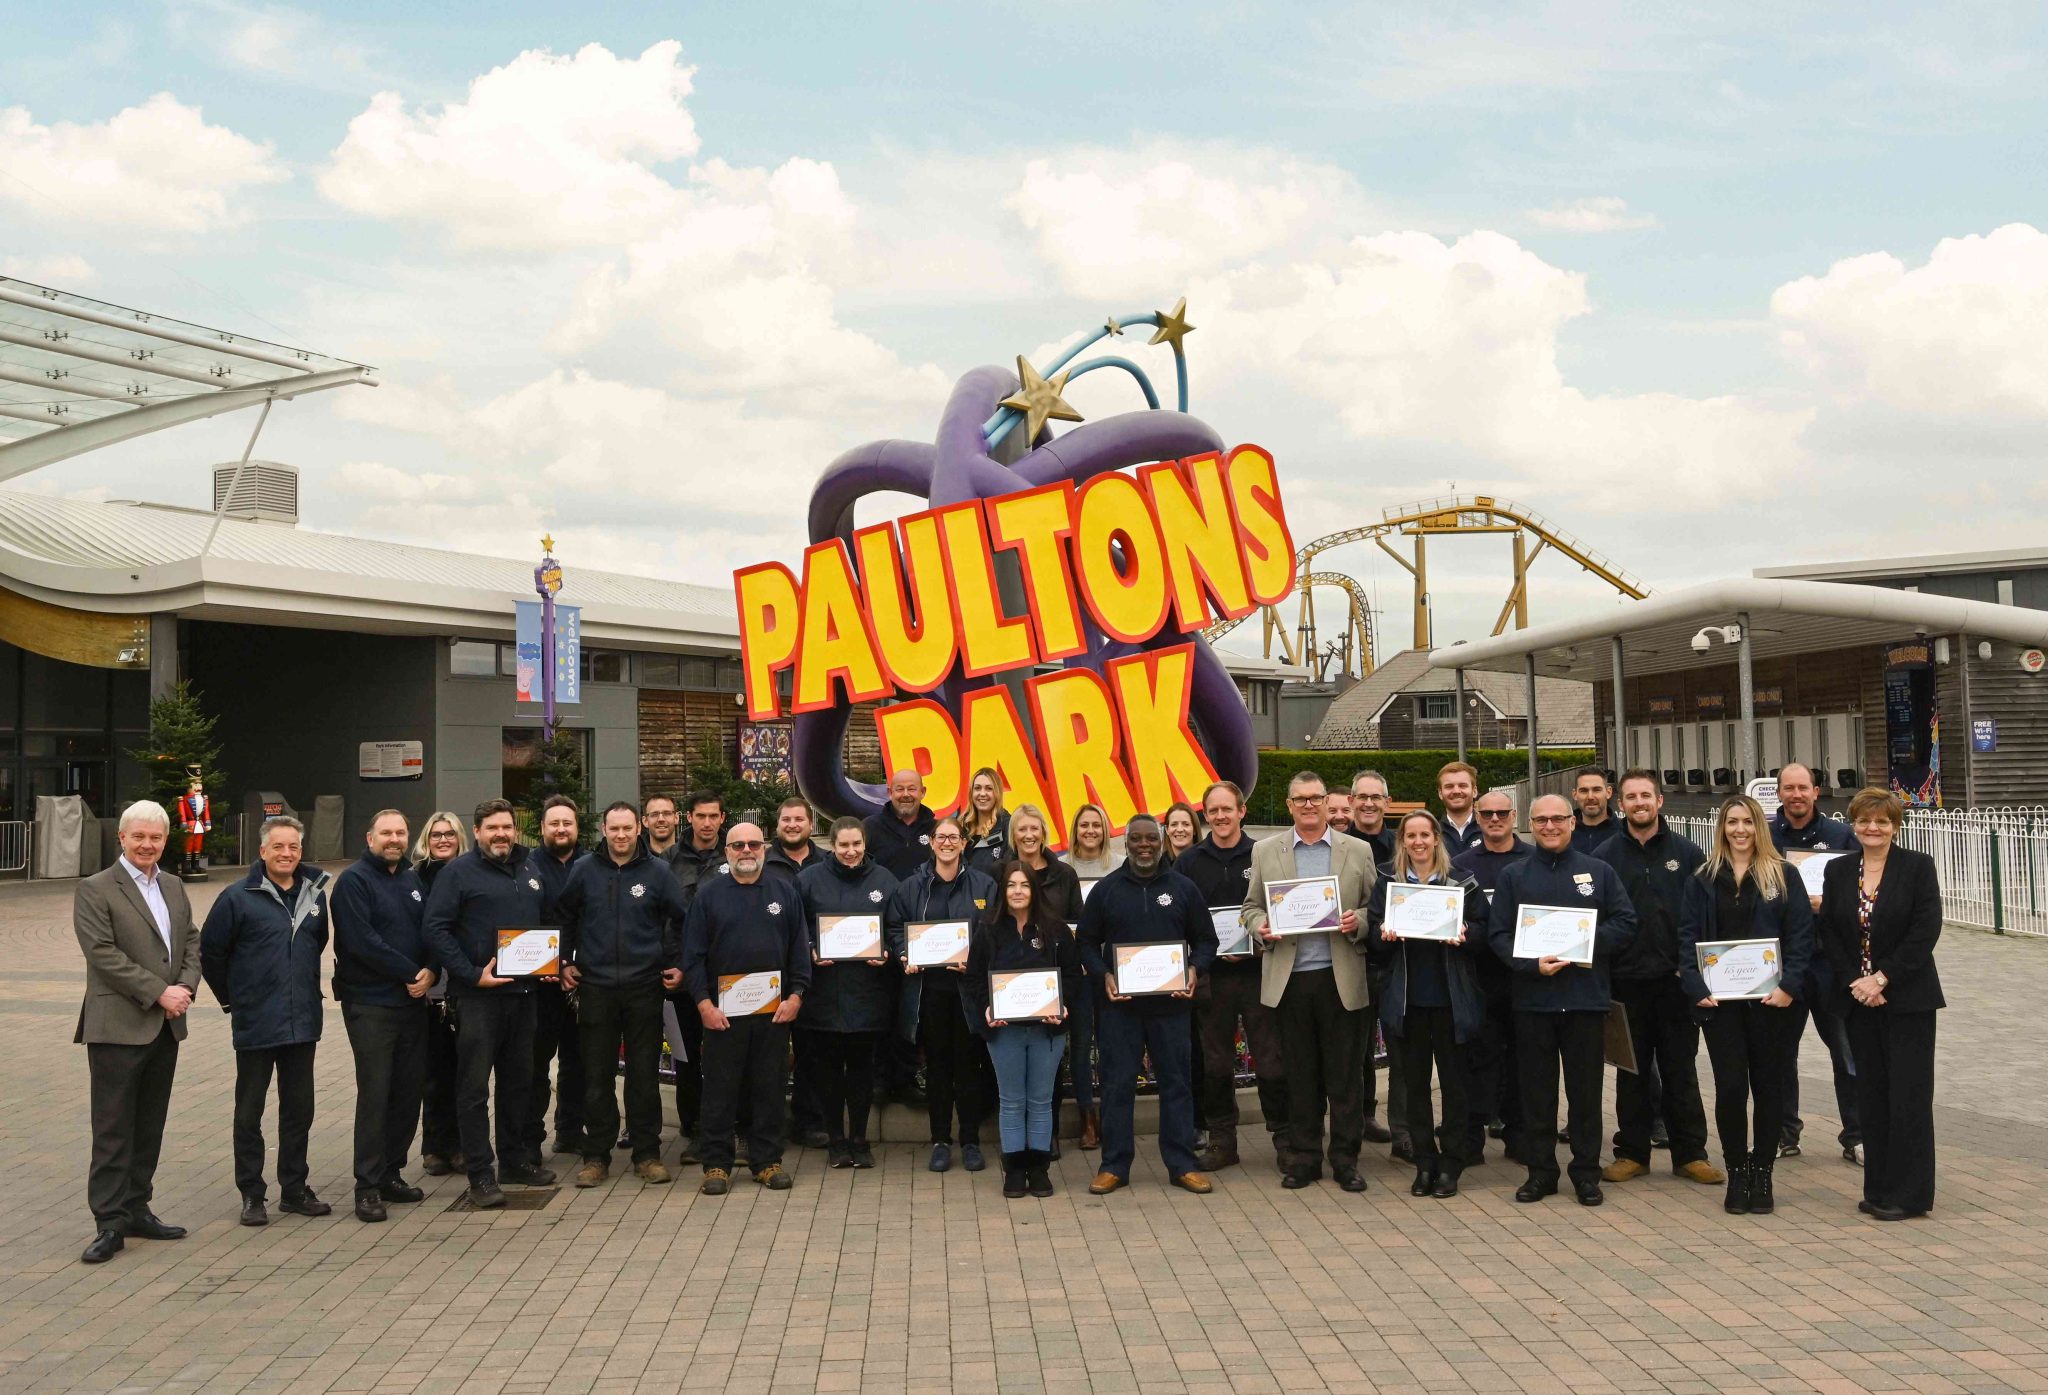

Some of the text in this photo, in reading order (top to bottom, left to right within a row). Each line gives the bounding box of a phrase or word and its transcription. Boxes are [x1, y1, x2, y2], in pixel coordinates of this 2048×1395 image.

[733, 443, 1297, 721] PAULTONS
[567, 611, 579, 697] welcome
[1888, 646, 1928, 666] WELCOME
[873, 642, 1221, 851] PARK
[1288, 903, 1319, 912] 20 year
[515, 948, 543, 958] 10 year
[1724, 966, 1757, 976] 15 year
[746, 991, 765, 999] year
[1022, 992, 1040, 1000] year
